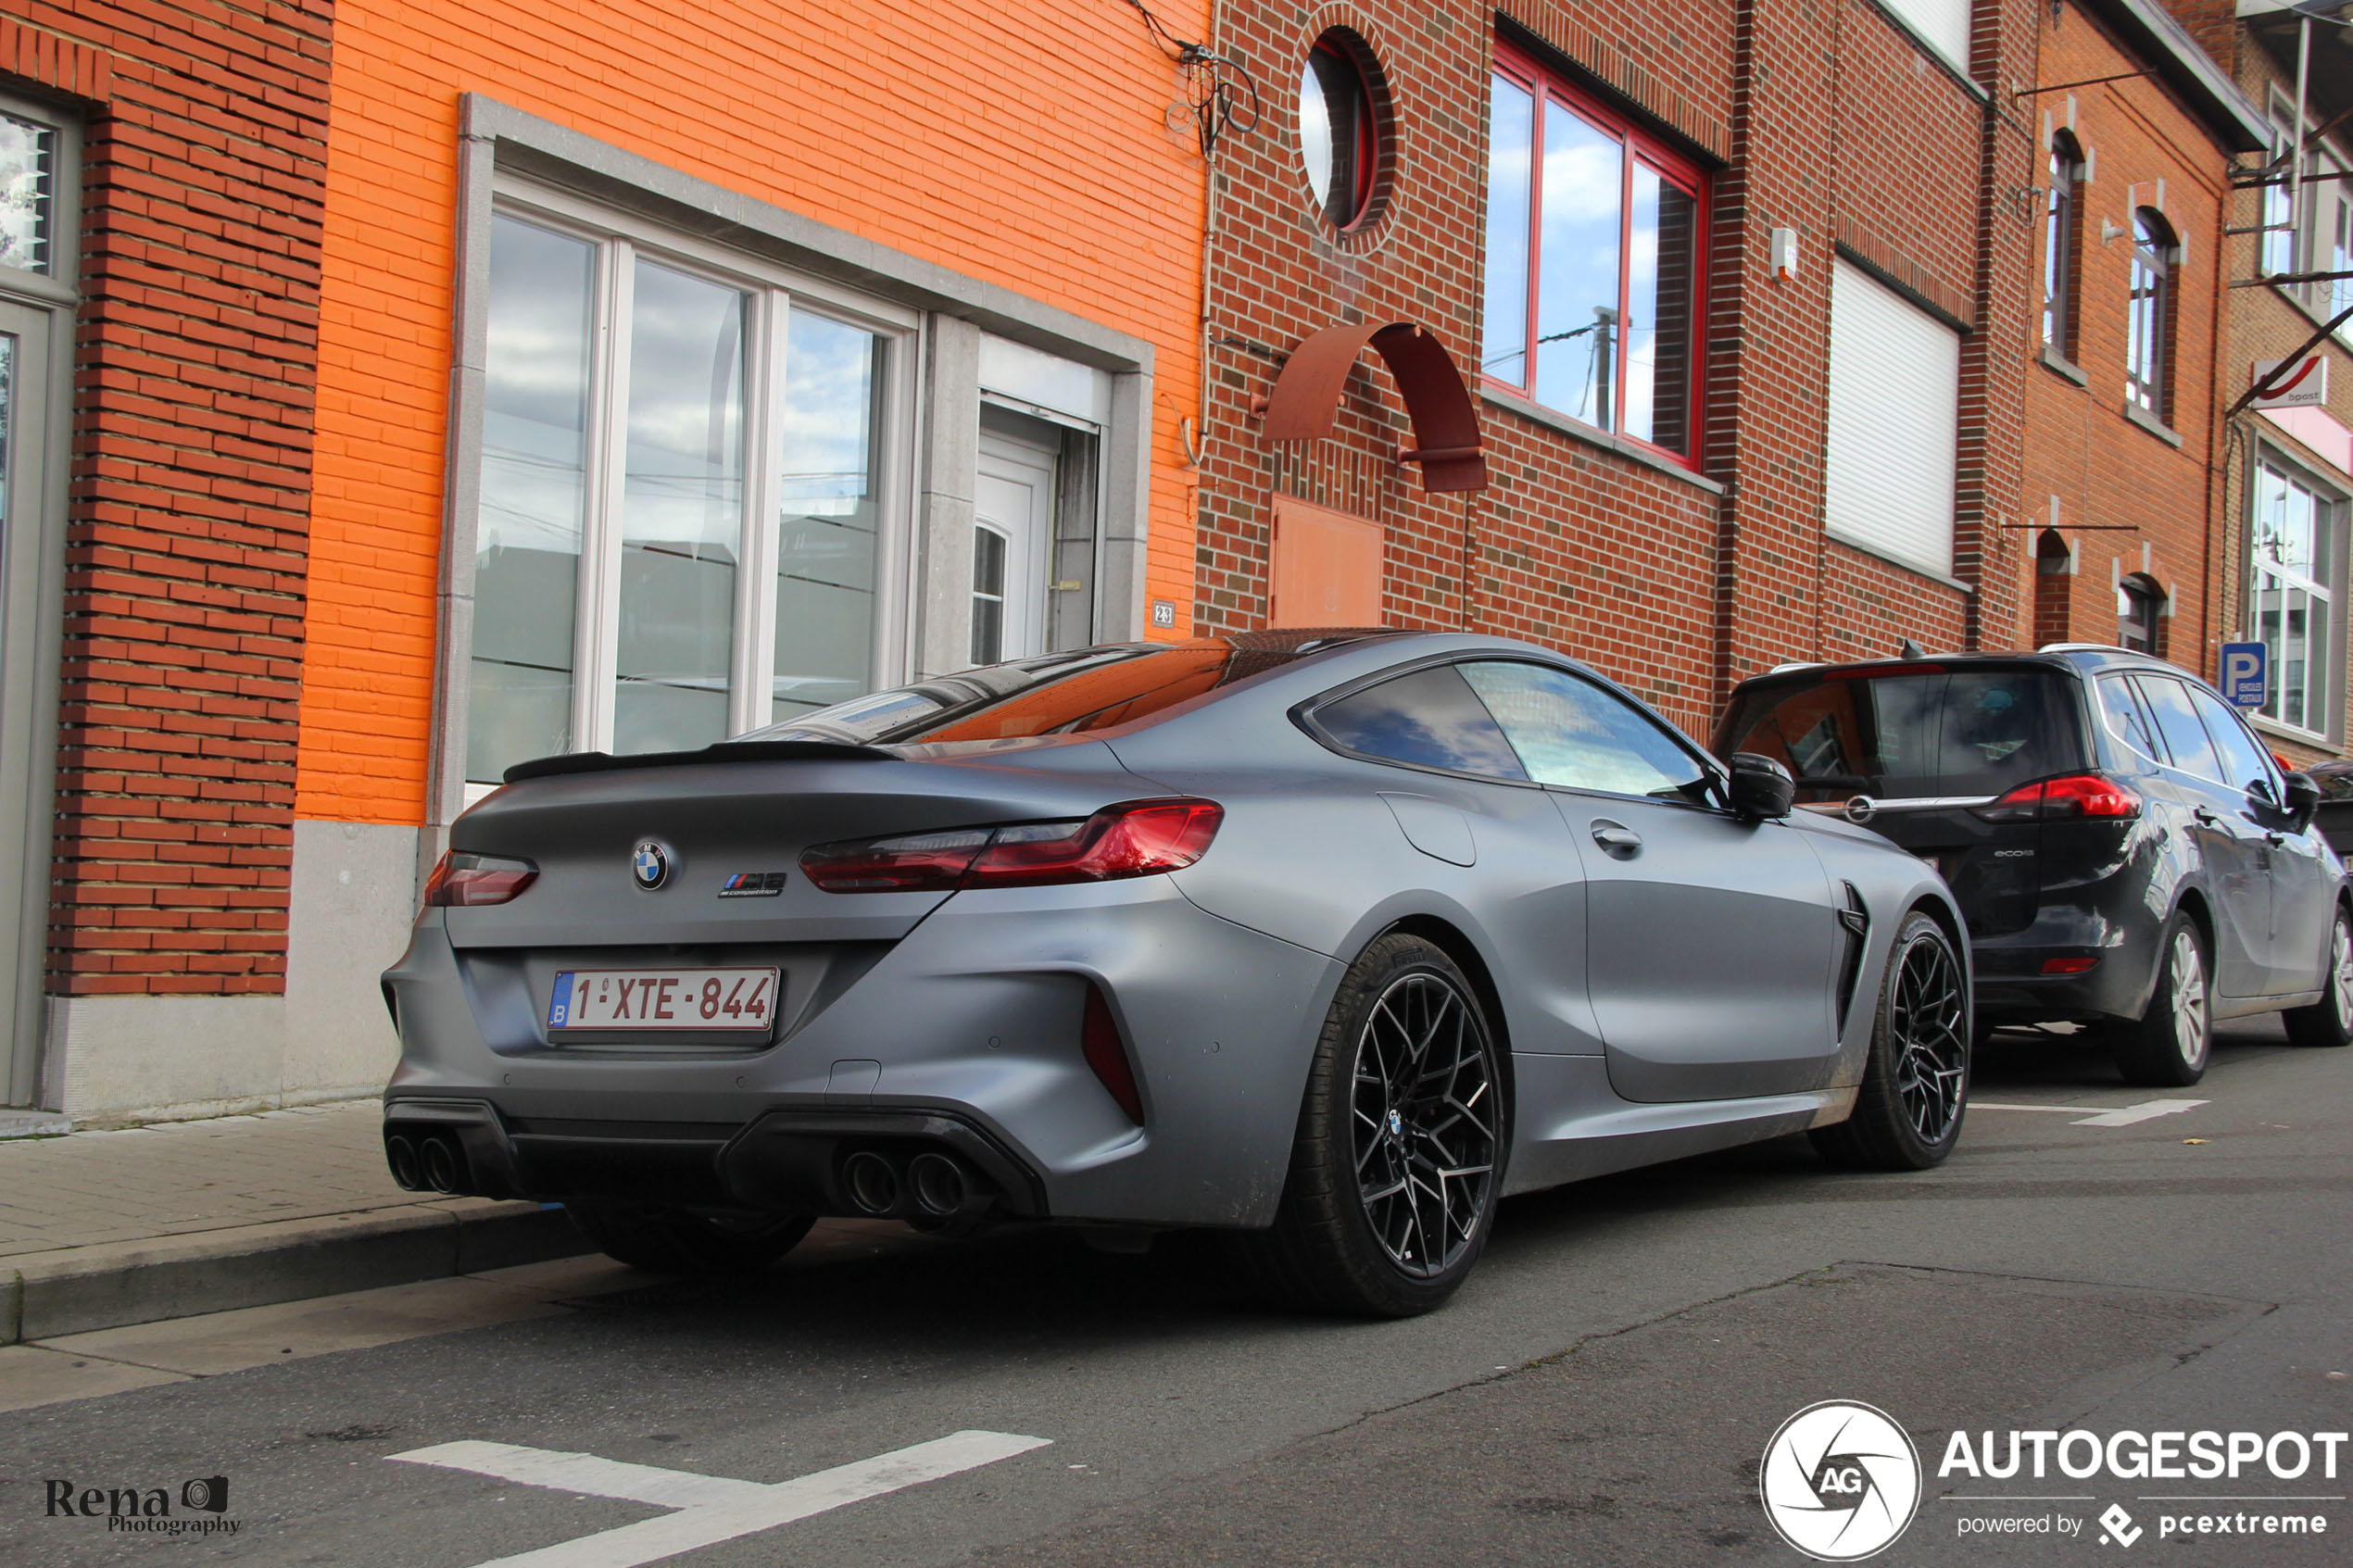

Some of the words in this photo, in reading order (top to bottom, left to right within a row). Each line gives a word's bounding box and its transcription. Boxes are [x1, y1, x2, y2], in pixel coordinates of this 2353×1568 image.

[2288, 392, 2320, 402] bpost
[1157, 607, 1170, 621] 23
[2226, 653, 2259, 696] P
[578, 977, 769, 1020] 1-XTE-844
[553, 1005, 566, 1023] B
